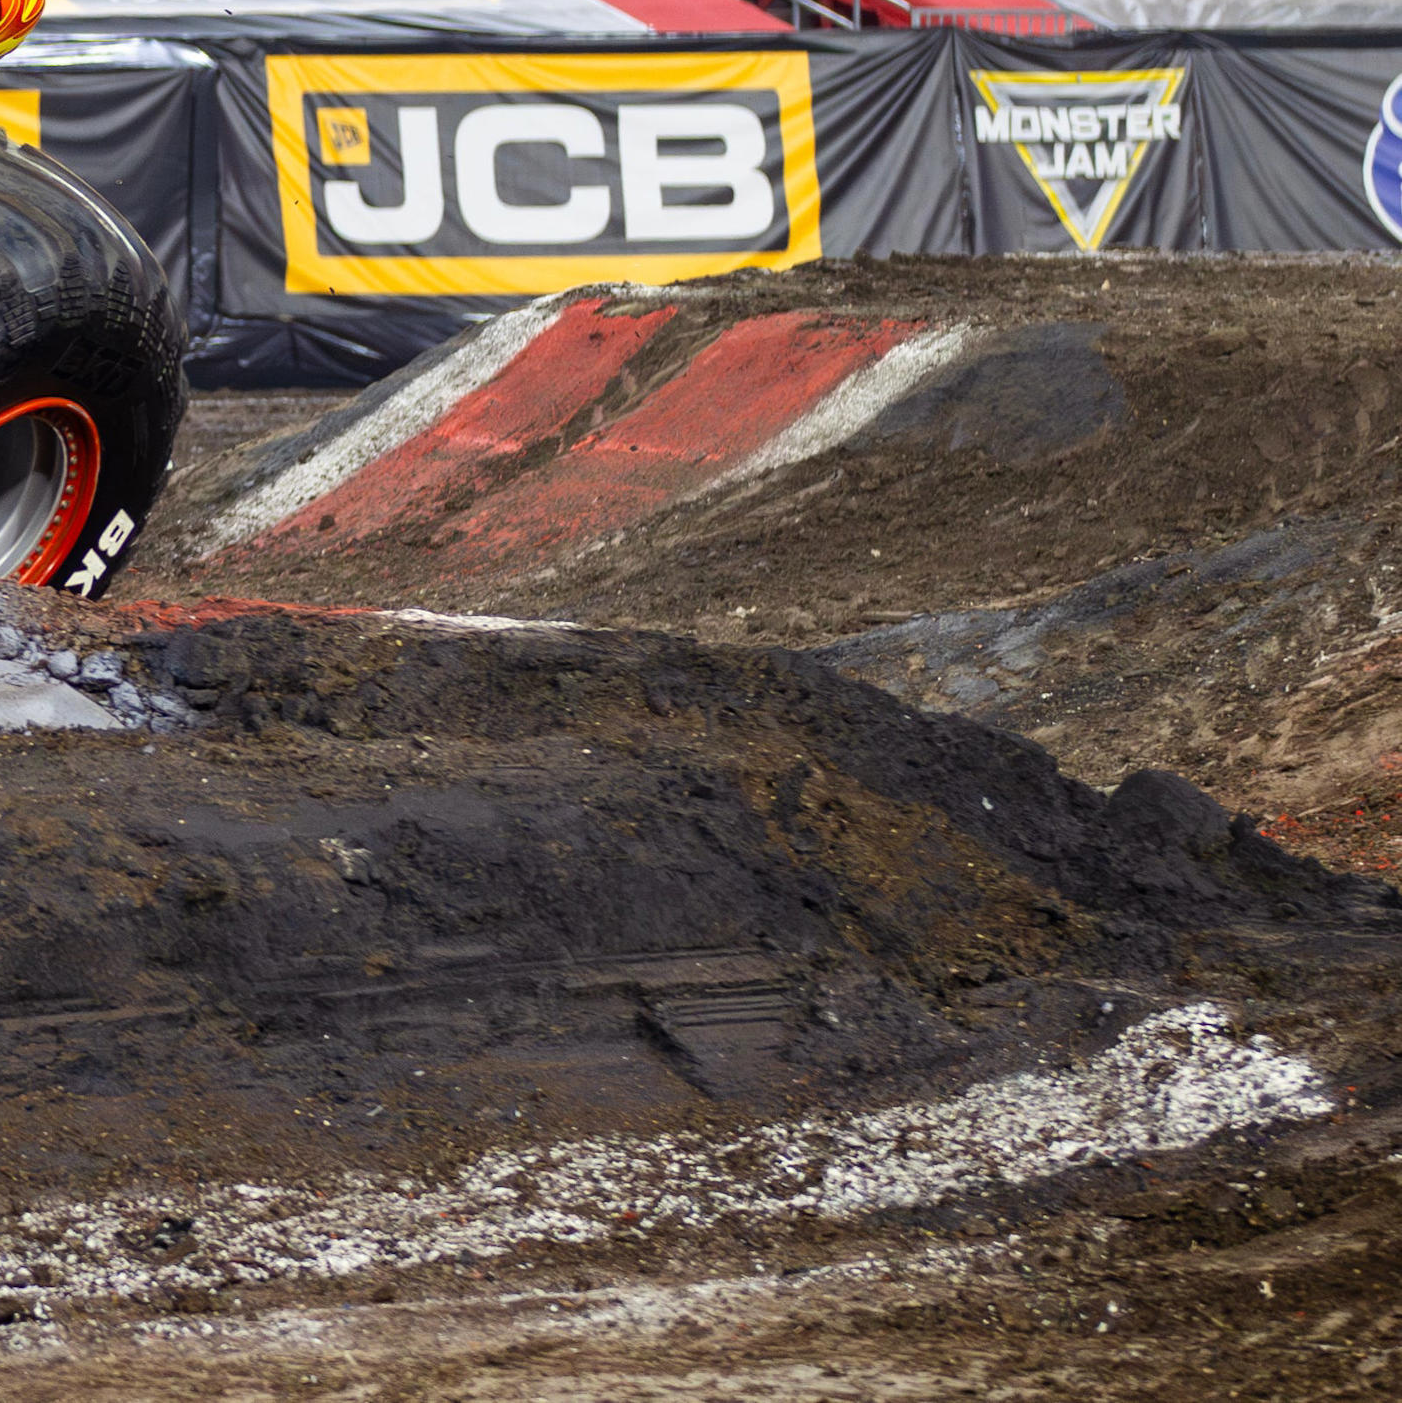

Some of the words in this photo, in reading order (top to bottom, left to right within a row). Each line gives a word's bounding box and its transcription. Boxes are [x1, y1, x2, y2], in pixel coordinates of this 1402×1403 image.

[975, 103, 1181, 143] MONSTER
[323, 104, 775, 245] JCB
[1037, 142, 1128, 179] JAM
[63, 508, 135, 598] BK
